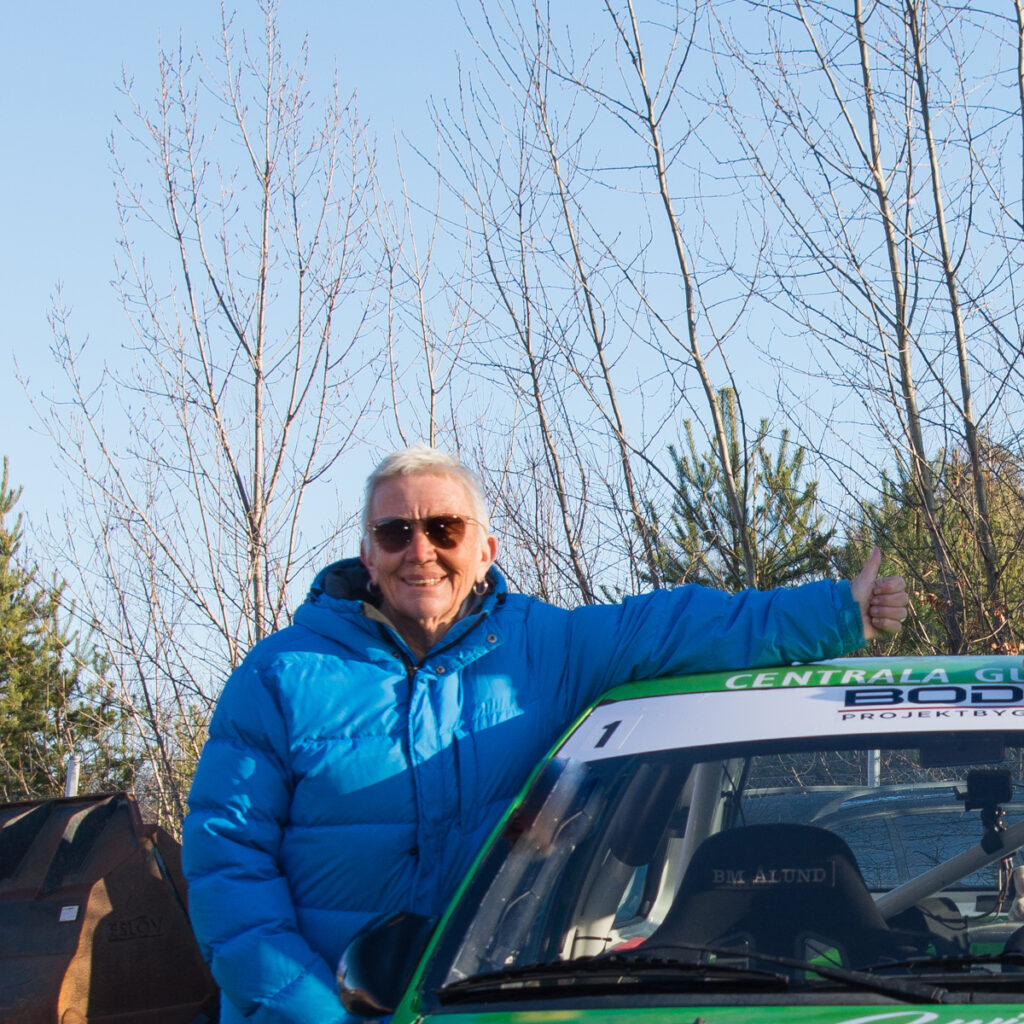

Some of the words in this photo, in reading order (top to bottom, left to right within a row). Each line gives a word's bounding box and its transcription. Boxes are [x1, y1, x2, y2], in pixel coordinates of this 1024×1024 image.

[725, 668, 950, 690] CENTRALA
[593, 720, 623, 749] 1
[713, 869, 745, 884] BM
